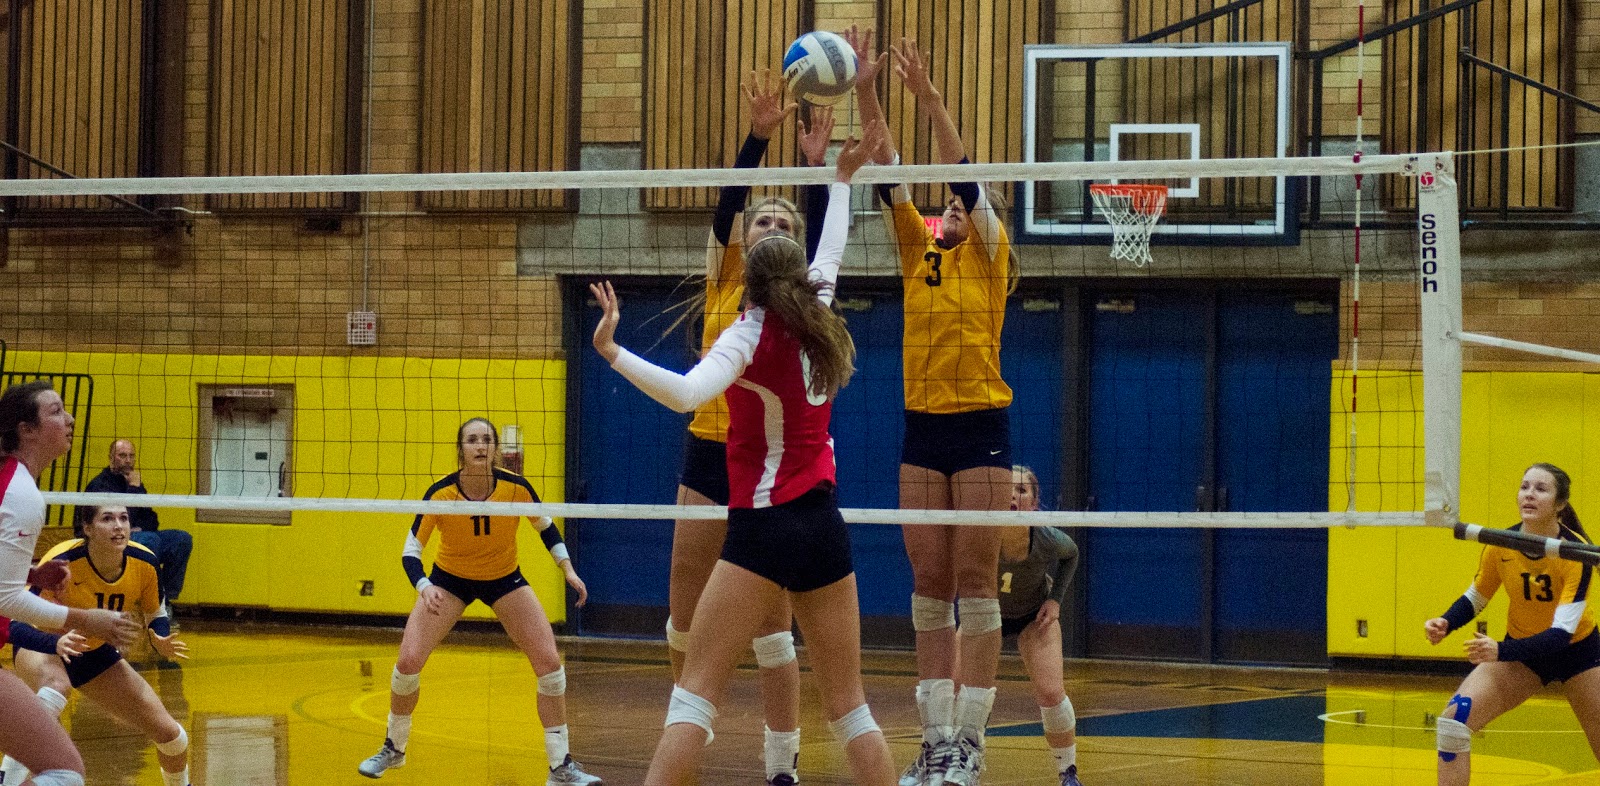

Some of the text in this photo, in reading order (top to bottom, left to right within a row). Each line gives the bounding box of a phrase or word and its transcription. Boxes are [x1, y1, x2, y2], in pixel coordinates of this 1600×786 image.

[1421, 213, 1438, 293] Senoh
[924, 251, 942, 287] 3
[470, 515, 491, 537] 11
[1000, 571, 1013, 594] 1
[1520, 572, 1553, 602] 13
[94, 592, 125, 612] 10
